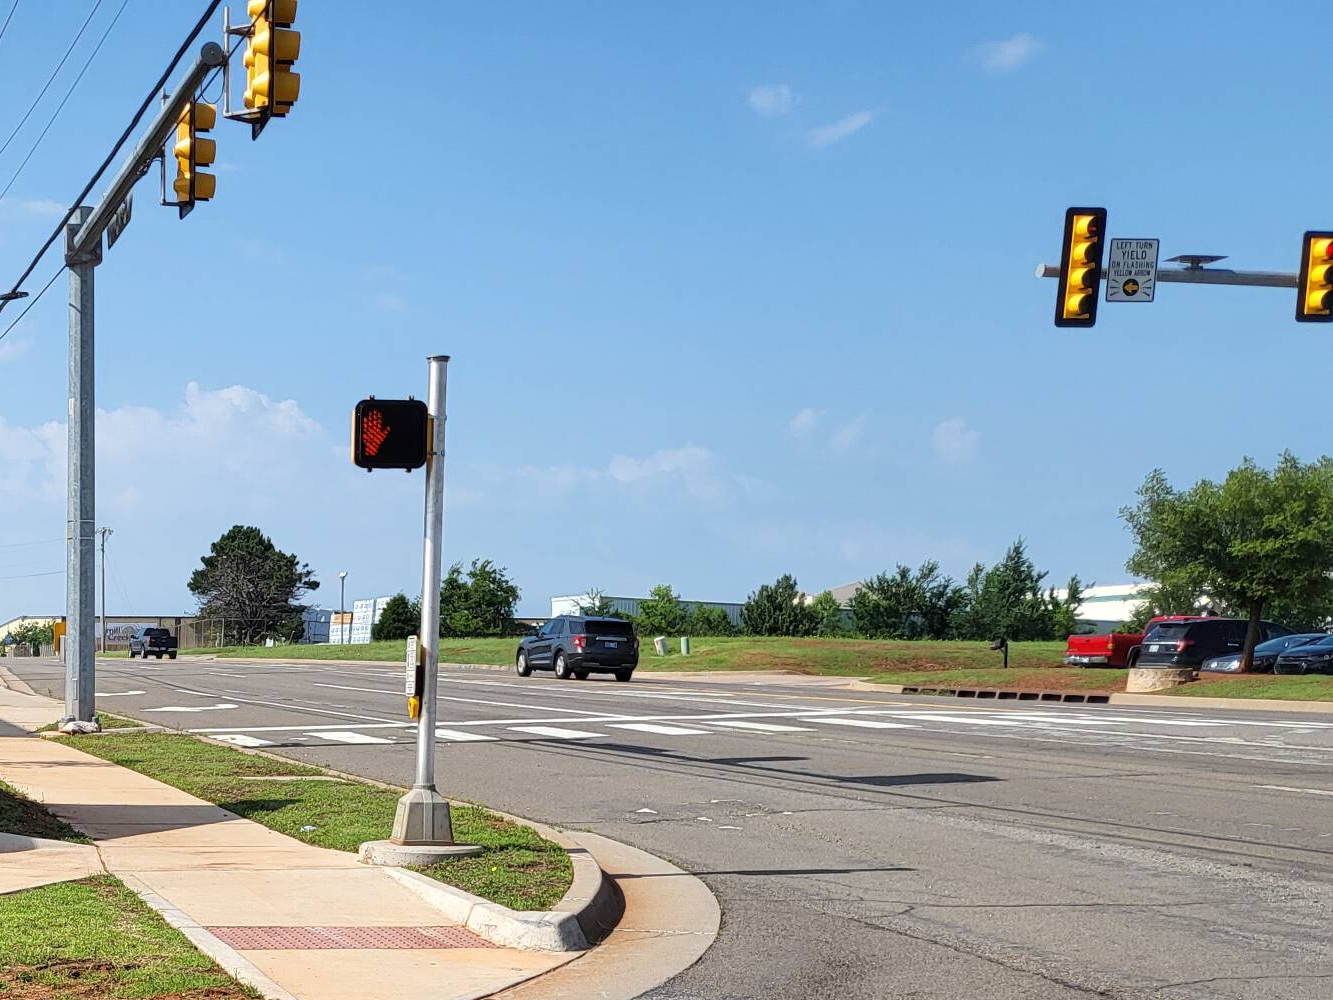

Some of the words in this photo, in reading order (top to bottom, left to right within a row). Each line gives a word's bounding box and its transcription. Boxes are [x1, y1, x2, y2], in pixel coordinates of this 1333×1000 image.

[1116, 241, 1132, 249] LEFT
[1135, 241, 1152, 249] TURN
[1122, 250, 1146, 260] YIELD
[1111, 260, 1121, 269] ON
[1122, 260, 1155, 269] FLASHING
